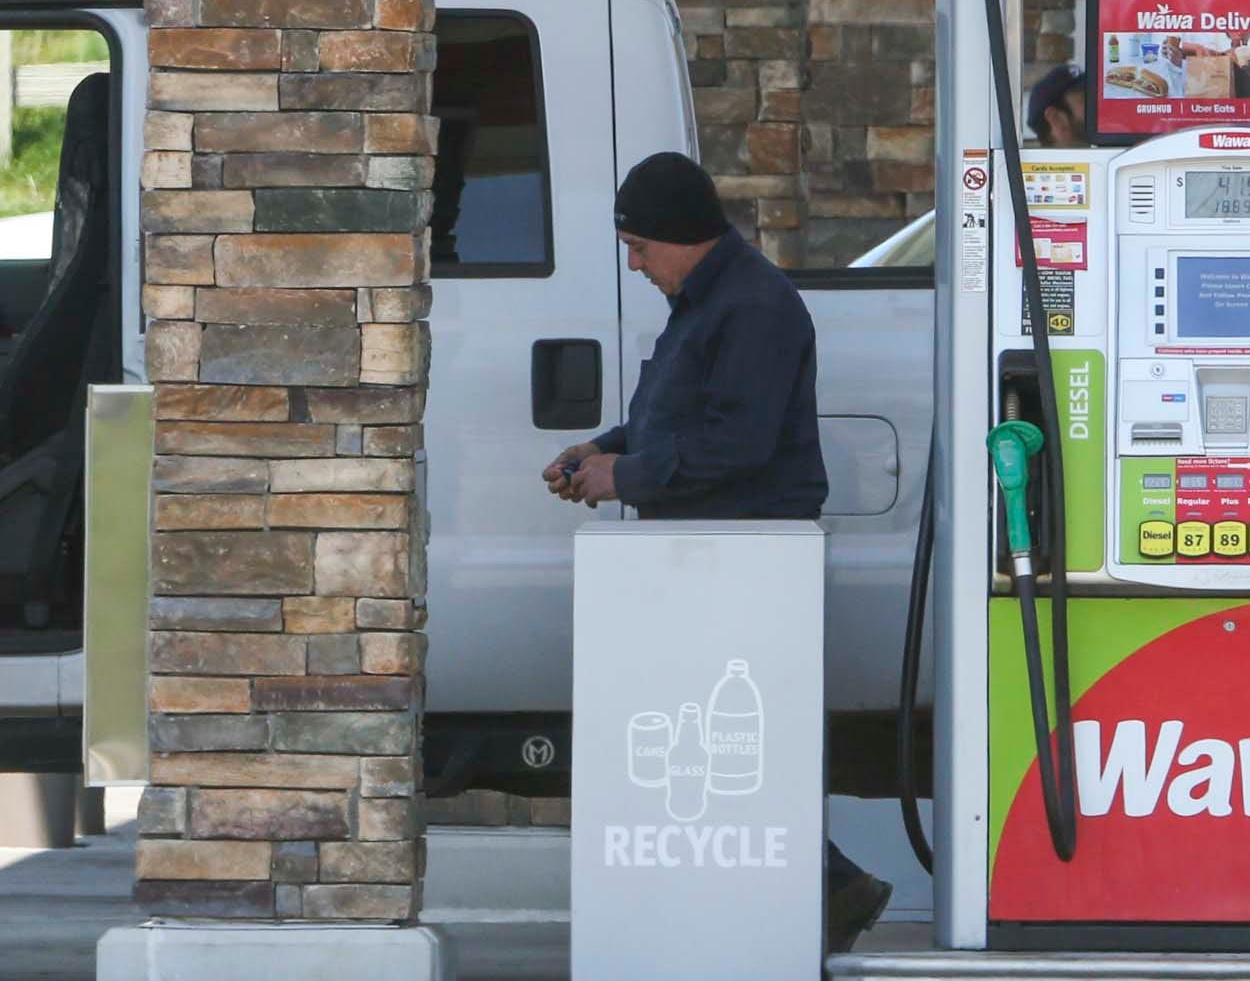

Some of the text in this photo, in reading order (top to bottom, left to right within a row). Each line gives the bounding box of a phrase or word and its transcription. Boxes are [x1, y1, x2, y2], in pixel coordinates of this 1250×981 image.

[1137, 11, 1193, 29] Wawa
[1136, 104, 1172, 114] GRUBHUB
[1191, 104, 1235, 113] Uber Eats
[1051, 317, 1070, 327] 40
[1070, 361, 1089, 439] DIESEL
[1143, 497, 1171, 505] Diesel
[1177, 497, 1211, 506] Regular
[1220, 497, 1239, 505] Plus
[1143, 530, 1171, 540] Diesel
[1184, 534, 1204, 547] 87
[1220, 534, 1240, 547] 89
[711, 731, 759, 742] PLASTIC
[635, 746, 665, 757] CANS
[671, 764, 704, 776] GLASS
[604, 825, 789, 868] RECYCLE
